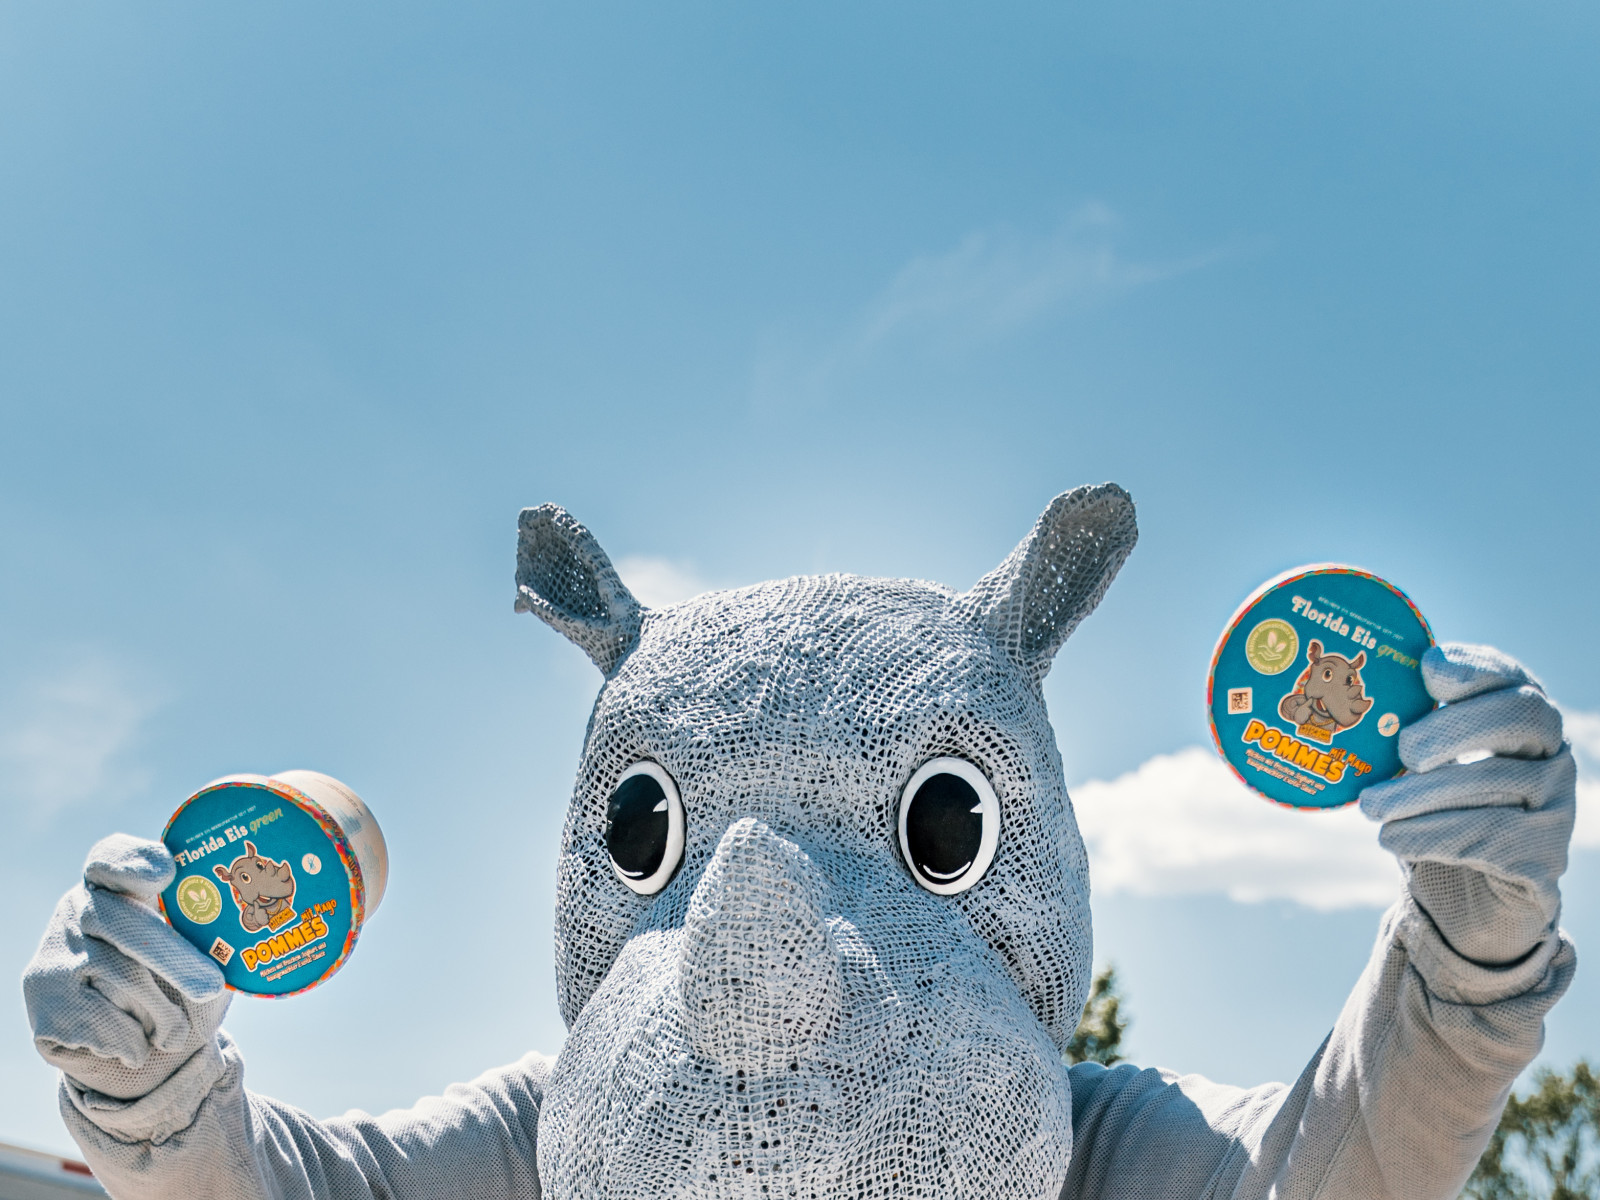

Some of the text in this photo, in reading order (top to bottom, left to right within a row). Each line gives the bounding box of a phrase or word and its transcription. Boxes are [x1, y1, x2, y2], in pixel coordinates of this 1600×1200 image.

[1291, 595, 1350, 637] Florida
[1351, 625, 1377, 650] Eis
[1376, 644, 1419, 669] green
[1242, 719, 1347, 783] POMMES
[174, 836, 227, 867] Florida
[224, 825, 249, 843] Eis
[249, 807, 284, 836] green
[241, 916, 328, 971] POMMES
